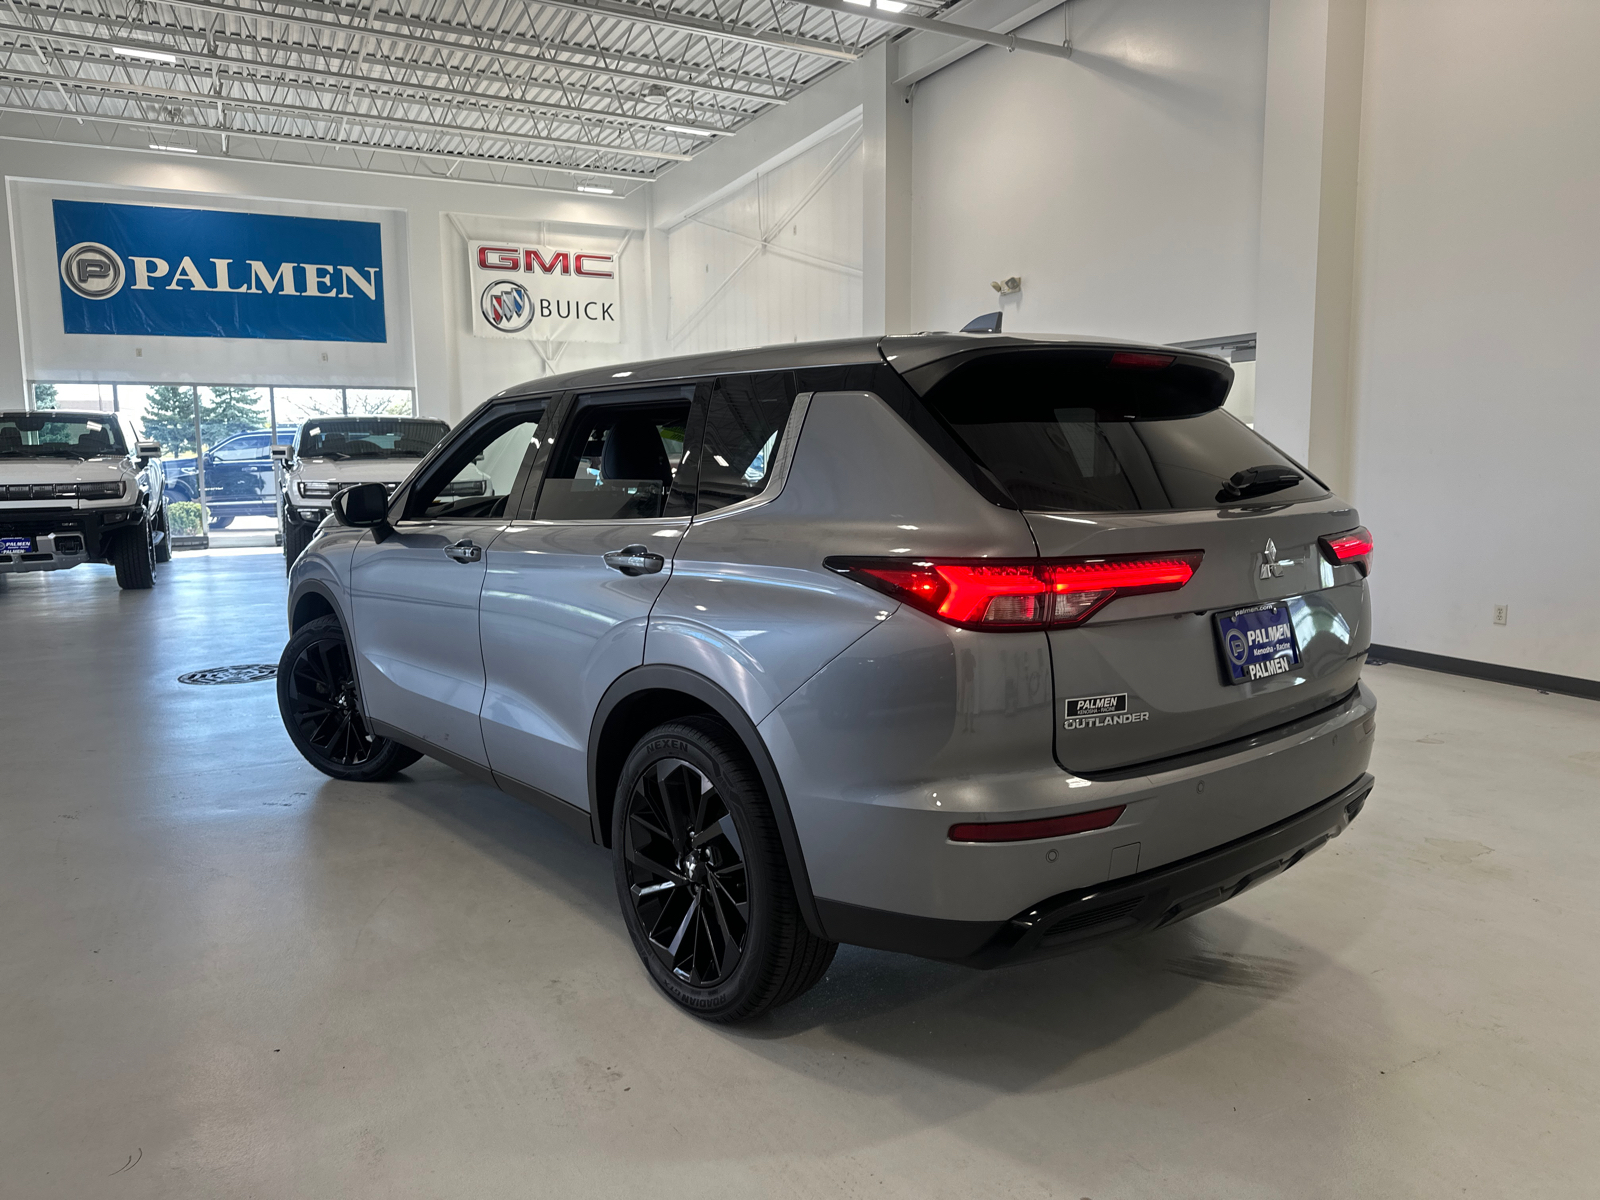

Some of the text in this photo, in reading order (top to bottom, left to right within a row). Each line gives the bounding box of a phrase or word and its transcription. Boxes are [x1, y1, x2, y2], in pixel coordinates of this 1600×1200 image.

[477, 244, 615, 279] GMC
[128, 255, 379, 301] PALMEN
[540, 298, 615, 322] BUICK
[1234, 604, 1274, 617] palmen.com
[1247, 623, 1291, 646] PALMEN
[1253, 645, 1274, 657] Kenosha
[1276, 642, 1291, 652] Racine
[1249, 657, 1289, 680] PALMEN
[1077, 697, 1118, 710] PALMEN
[1064, 711, 1150, 730] OUTLANDER
[646, 739, 688, 754] NEXEN
